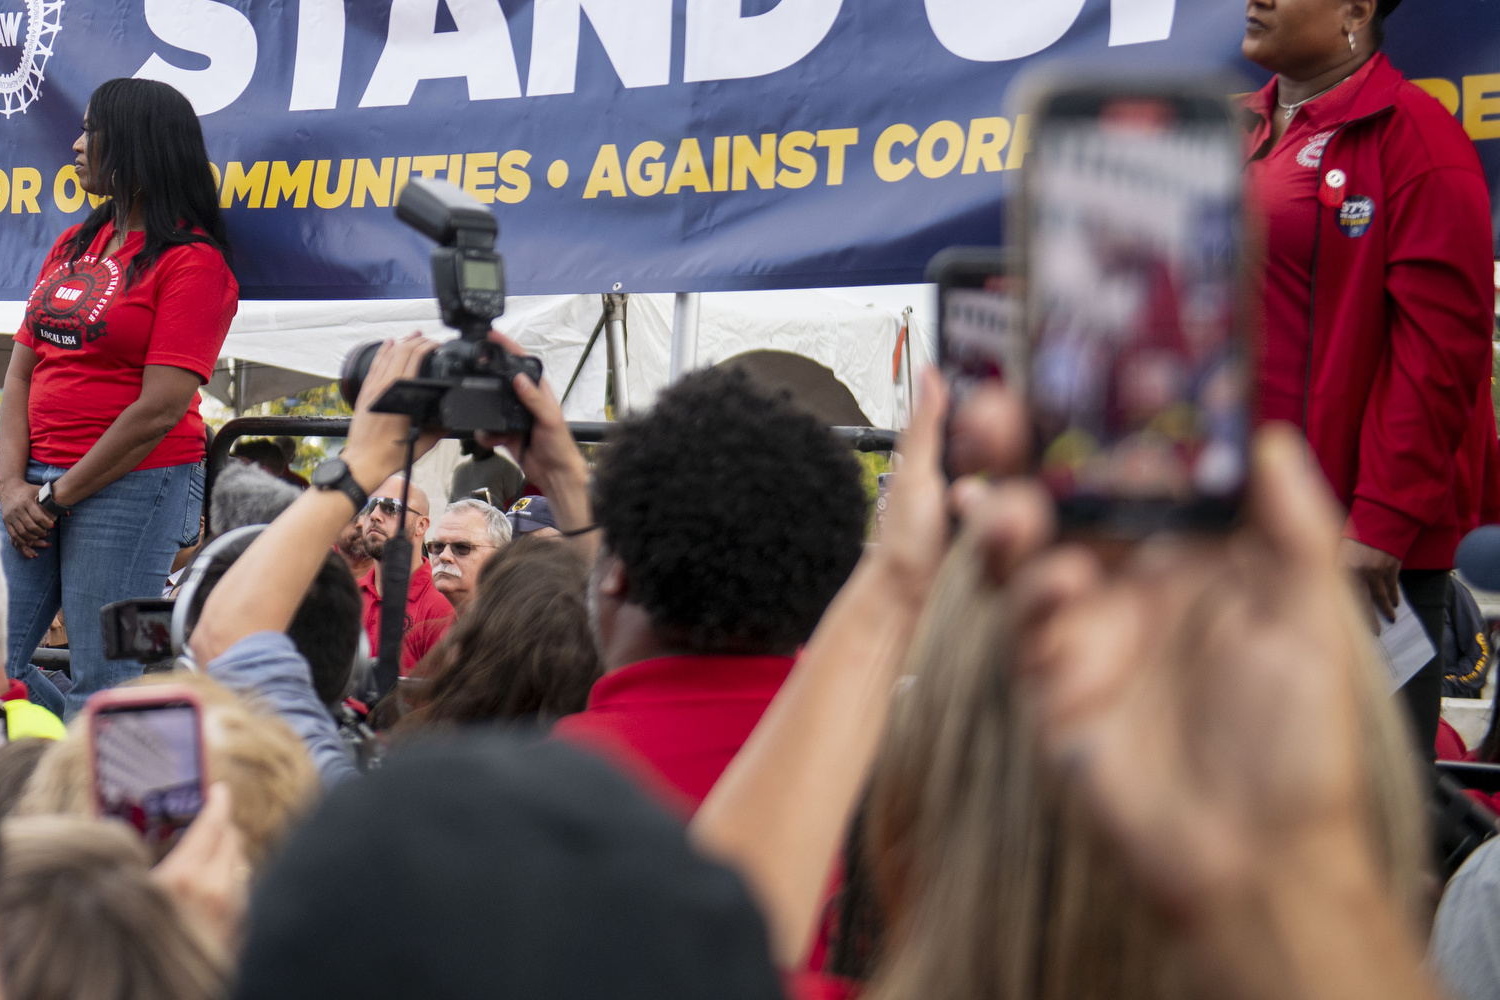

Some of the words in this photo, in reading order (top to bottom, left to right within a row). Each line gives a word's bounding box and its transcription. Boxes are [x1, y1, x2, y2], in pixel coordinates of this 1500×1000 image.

[209, 150, 532, 210] MMUNITIES
[582, 128, 859, 199] AGAINST
[55, 286, 83, 301] UAW
[88, 298, 108, 322] EVER
[40, 329, 61, 344] LOCAL
